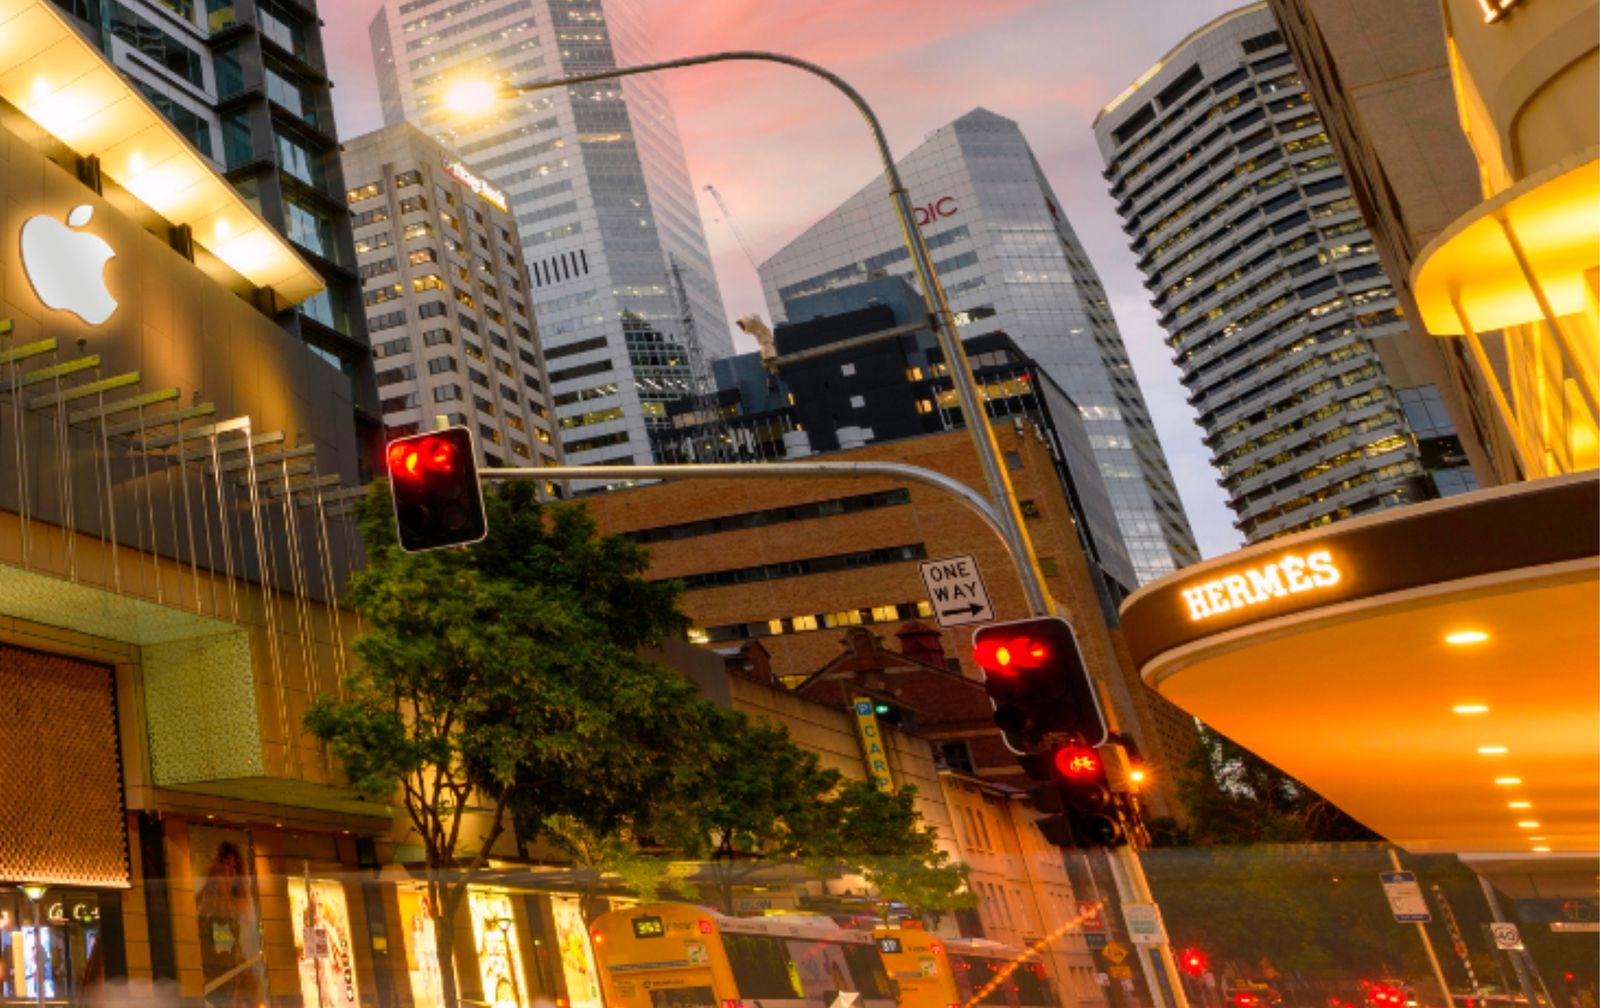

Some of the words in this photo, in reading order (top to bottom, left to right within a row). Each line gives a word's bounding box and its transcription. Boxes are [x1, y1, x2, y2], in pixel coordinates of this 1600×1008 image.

[930, 561, 971, 582] ONE
[933, 581, 976, 602] WAY
[1181, 550, 1341, 621] HERMÈS
